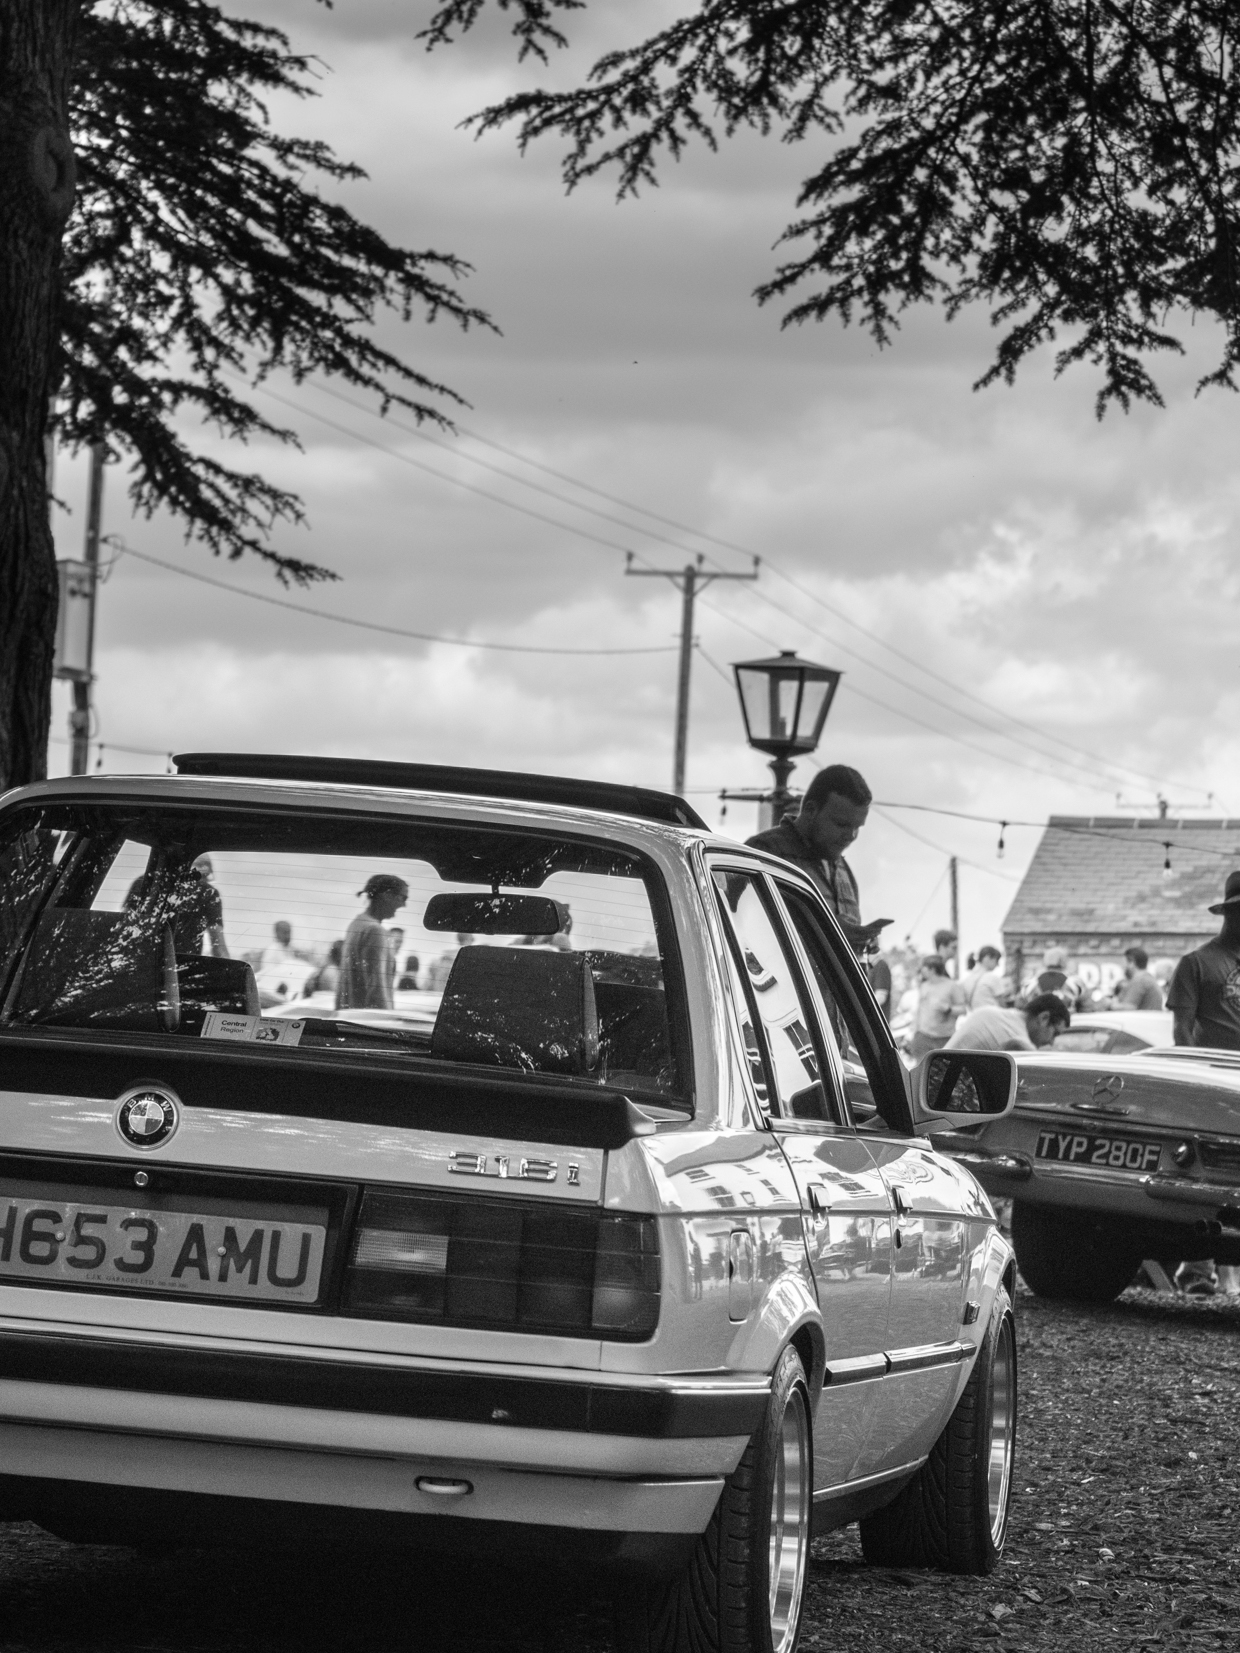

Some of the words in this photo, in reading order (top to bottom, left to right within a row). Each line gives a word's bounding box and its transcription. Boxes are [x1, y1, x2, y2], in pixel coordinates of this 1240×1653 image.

[1040, 1131, 1088, 1161] TYP
[1091, 1139, 1161, 1170] 280F
[171, 1222, 313, 1288] AMU
